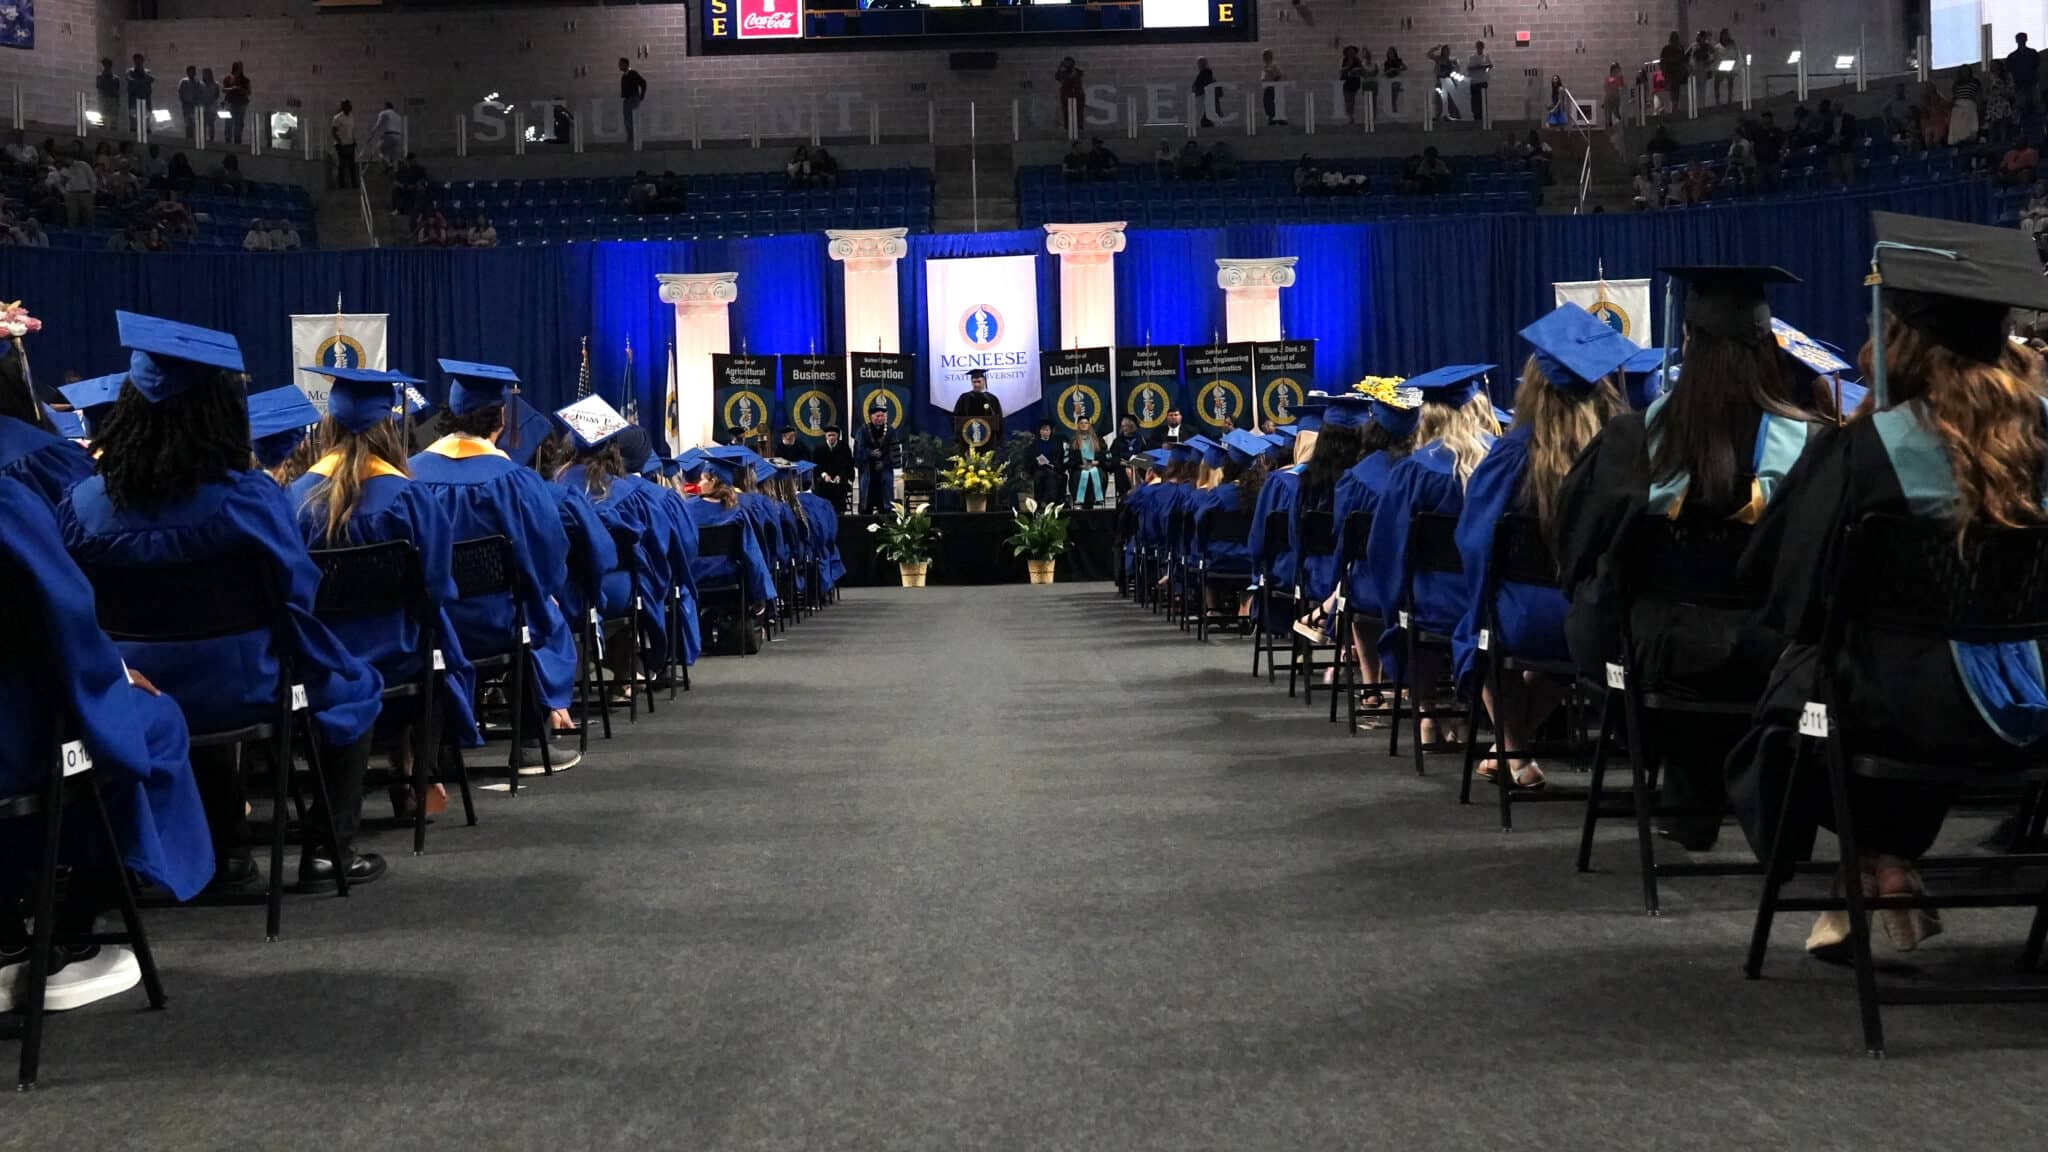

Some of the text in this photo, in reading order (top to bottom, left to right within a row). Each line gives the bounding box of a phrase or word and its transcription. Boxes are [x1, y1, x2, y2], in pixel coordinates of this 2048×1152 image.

[792, 369, 837, 381] Business
[860, 367, 904, 380] Education
[1049, 362, 1105, 377] Liberal Arts
